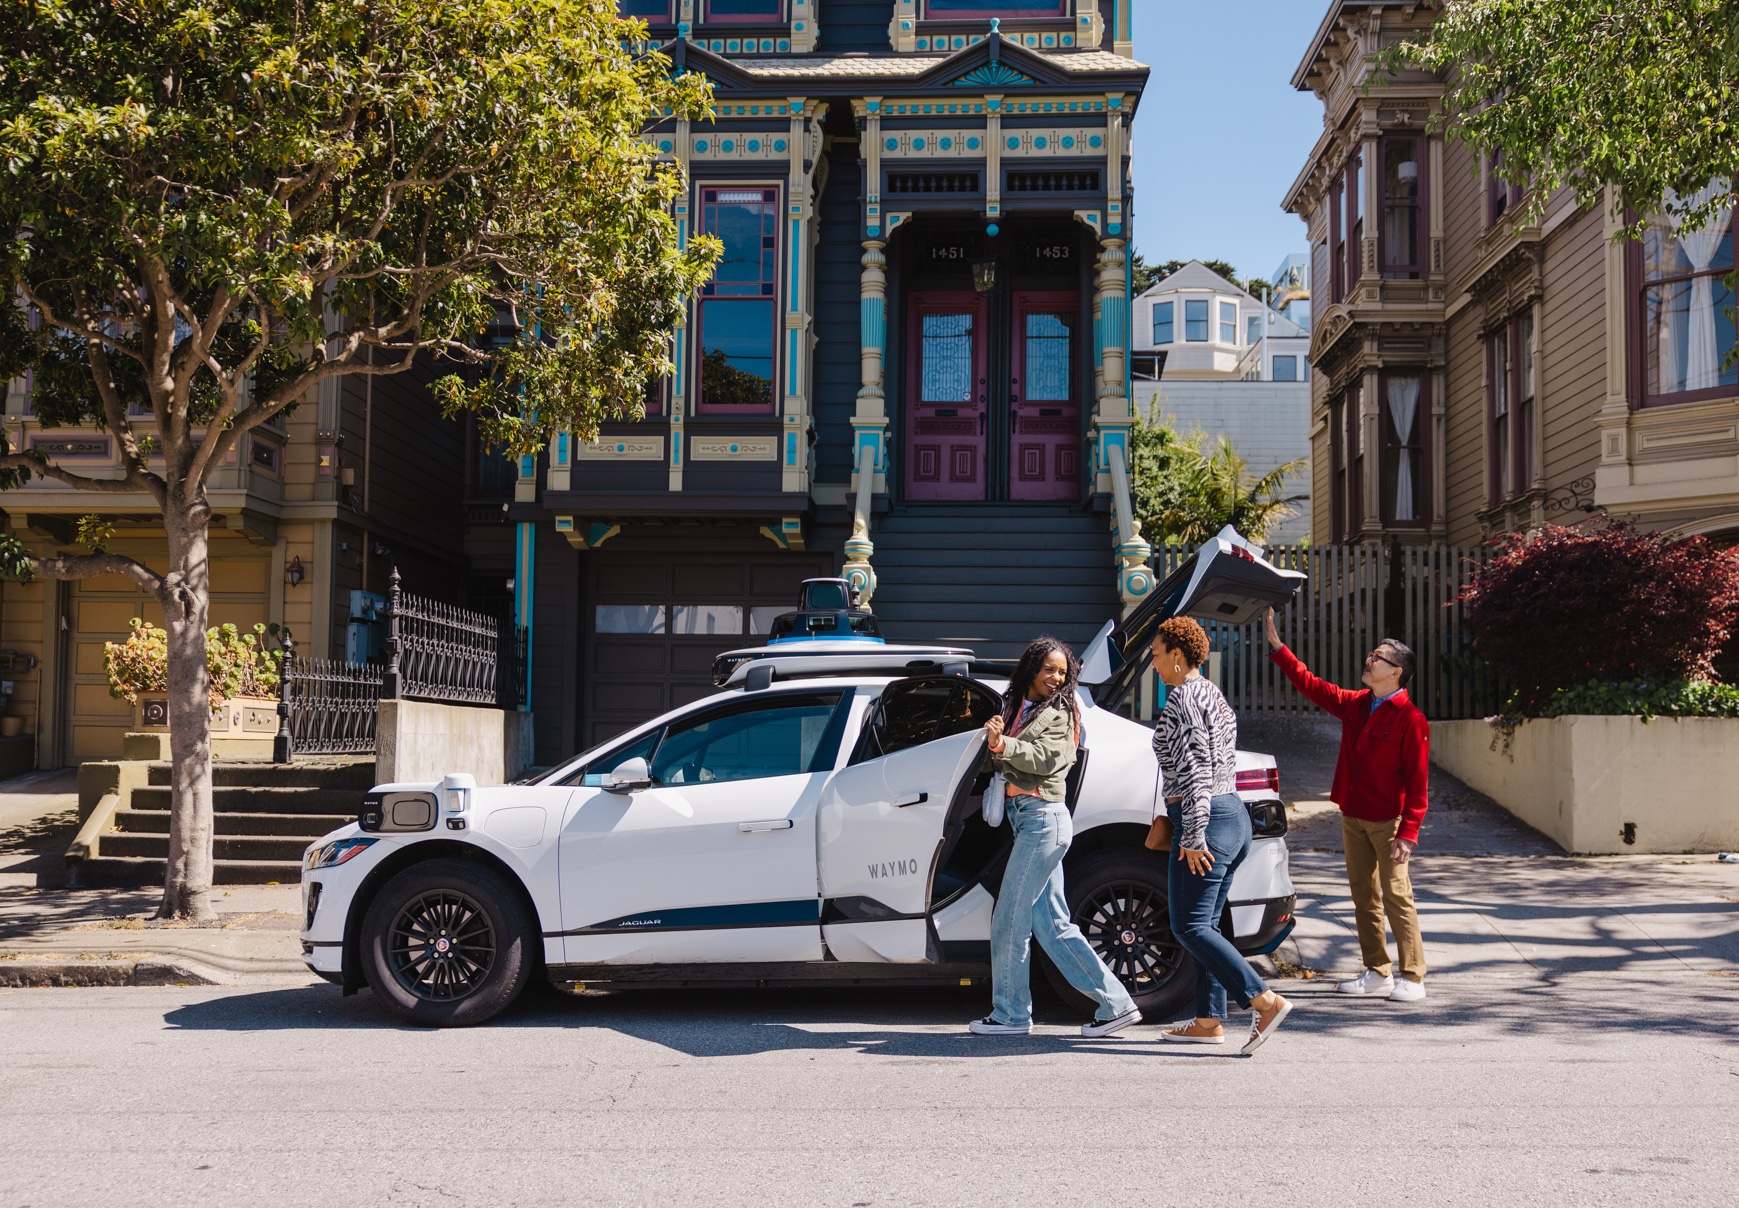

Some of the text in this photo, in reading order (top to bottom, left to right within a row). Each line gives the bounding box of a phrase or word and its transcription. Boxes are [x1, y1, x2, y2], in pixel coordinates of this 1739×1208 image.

[932, 247, 964, 259] 1451
[1036, 246, 1069, 258] 1453
[868, 858, 918, 878] WAYMO
[619, 919, 661, 927] JAGUAR
